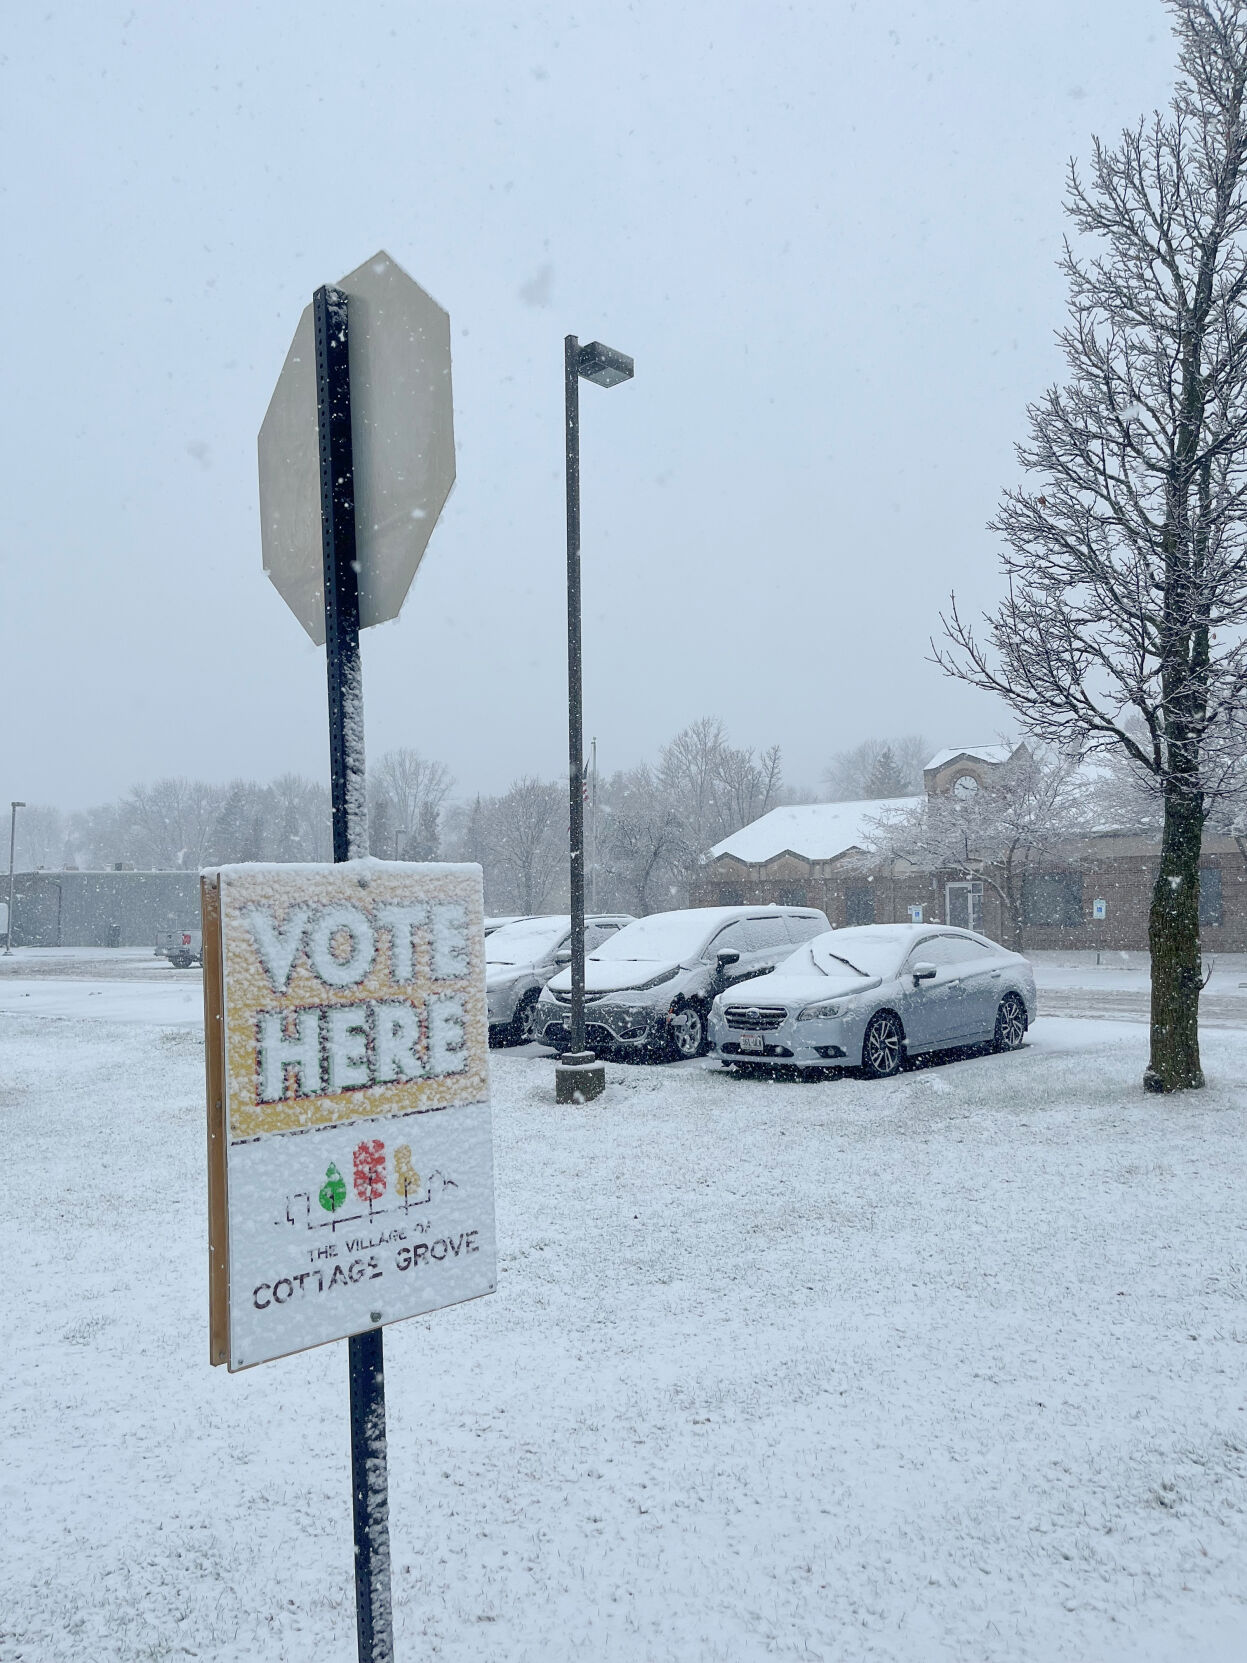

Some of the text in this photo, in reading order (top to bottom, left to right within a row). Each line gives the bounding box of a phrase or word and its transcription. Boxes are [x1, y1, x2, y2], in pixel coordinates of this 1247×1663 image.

[240, 900, 470, 996] VOTE
[254, 993, 468, 1106] HERE
[252, 1229, 480, 1310] COTTAGE GROVE
[307, 1244, 339, 1262] THE
[345, 1229, 407, 1253] VILLAGE
